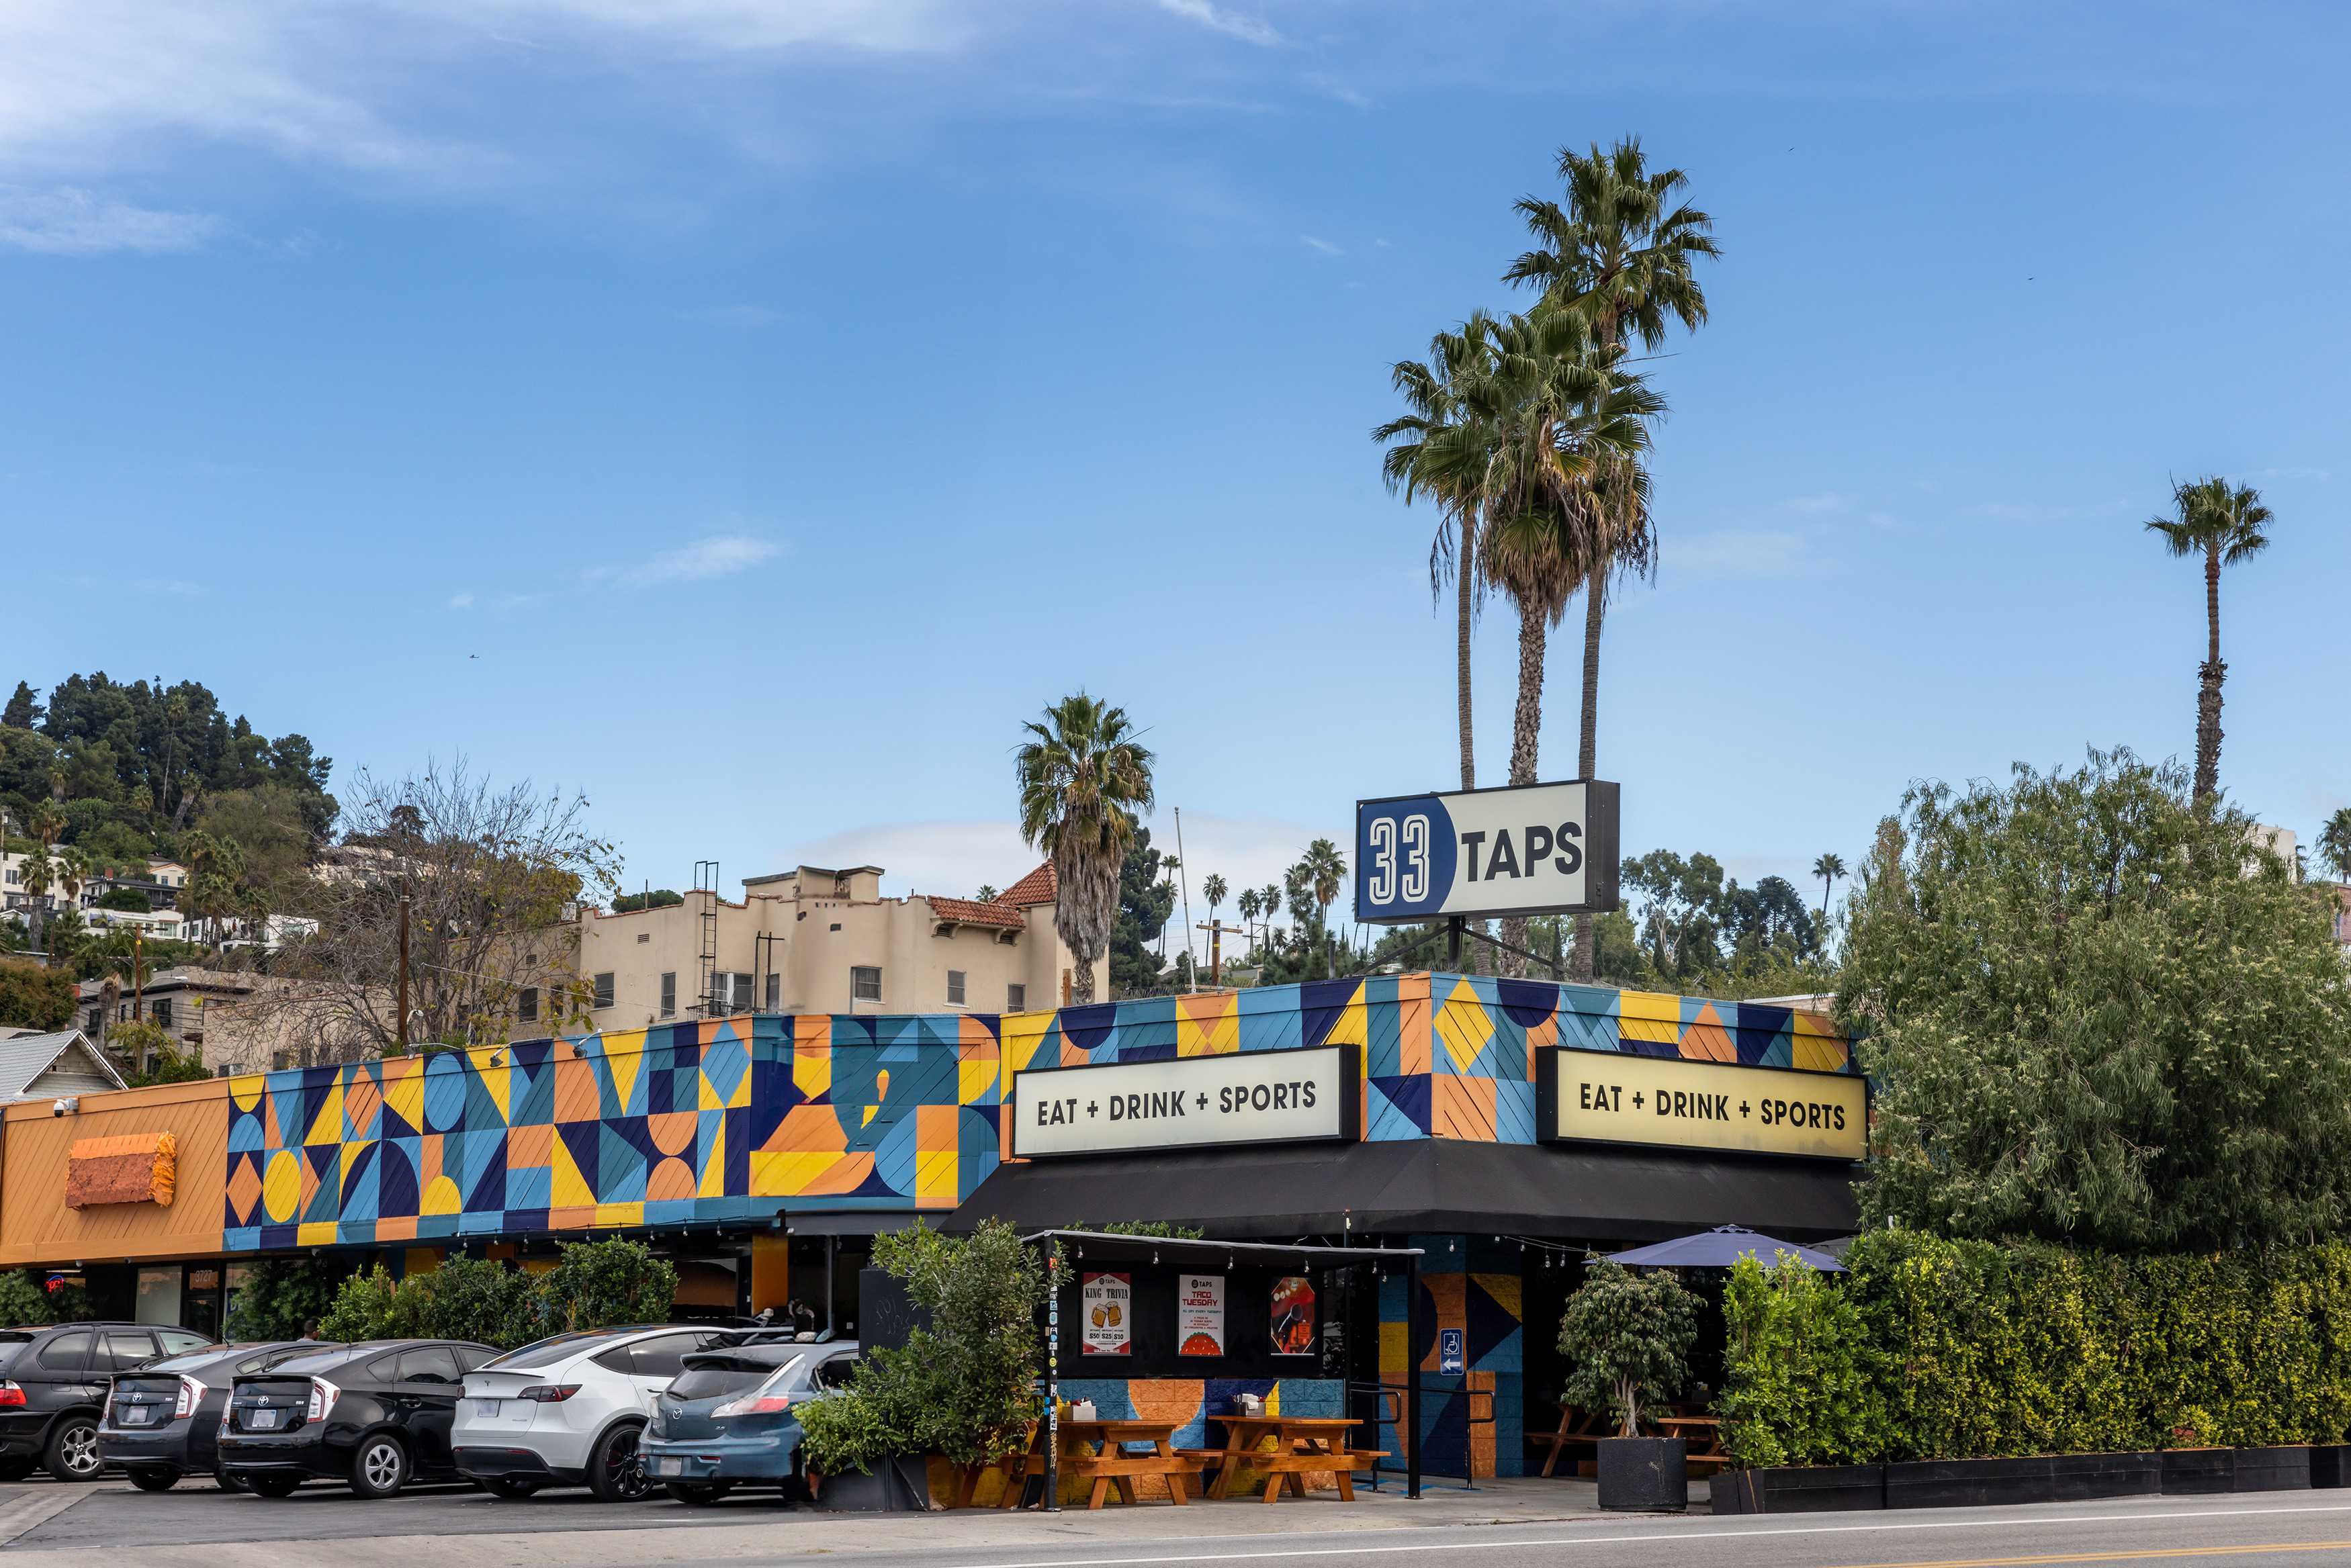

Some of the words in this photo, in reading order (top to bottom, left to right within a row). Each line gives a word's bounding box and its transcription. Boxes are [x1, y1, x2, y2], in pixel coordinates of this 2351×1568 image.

[1369, 814, 1430, 905] 33
[1461, 821, 1583, 882] TAPS
[1038, 1099, 1078, 1126] EAT
[1110, 1090, 1186, 1121] DRINK
[1219, 1080, 1317, 1114] SPORTS
[1580, 1082, 1622, 1113] EAT
[1656, 1089, 1730, 1121] DRINK
[1761, 1099, 1846, 1131] SPORTS
[195, 1269, 213, 1283] 3727
[1085, 1288, 1102, 1298] KING
[1106, 1289, 1128, 1299] TRIVIA
